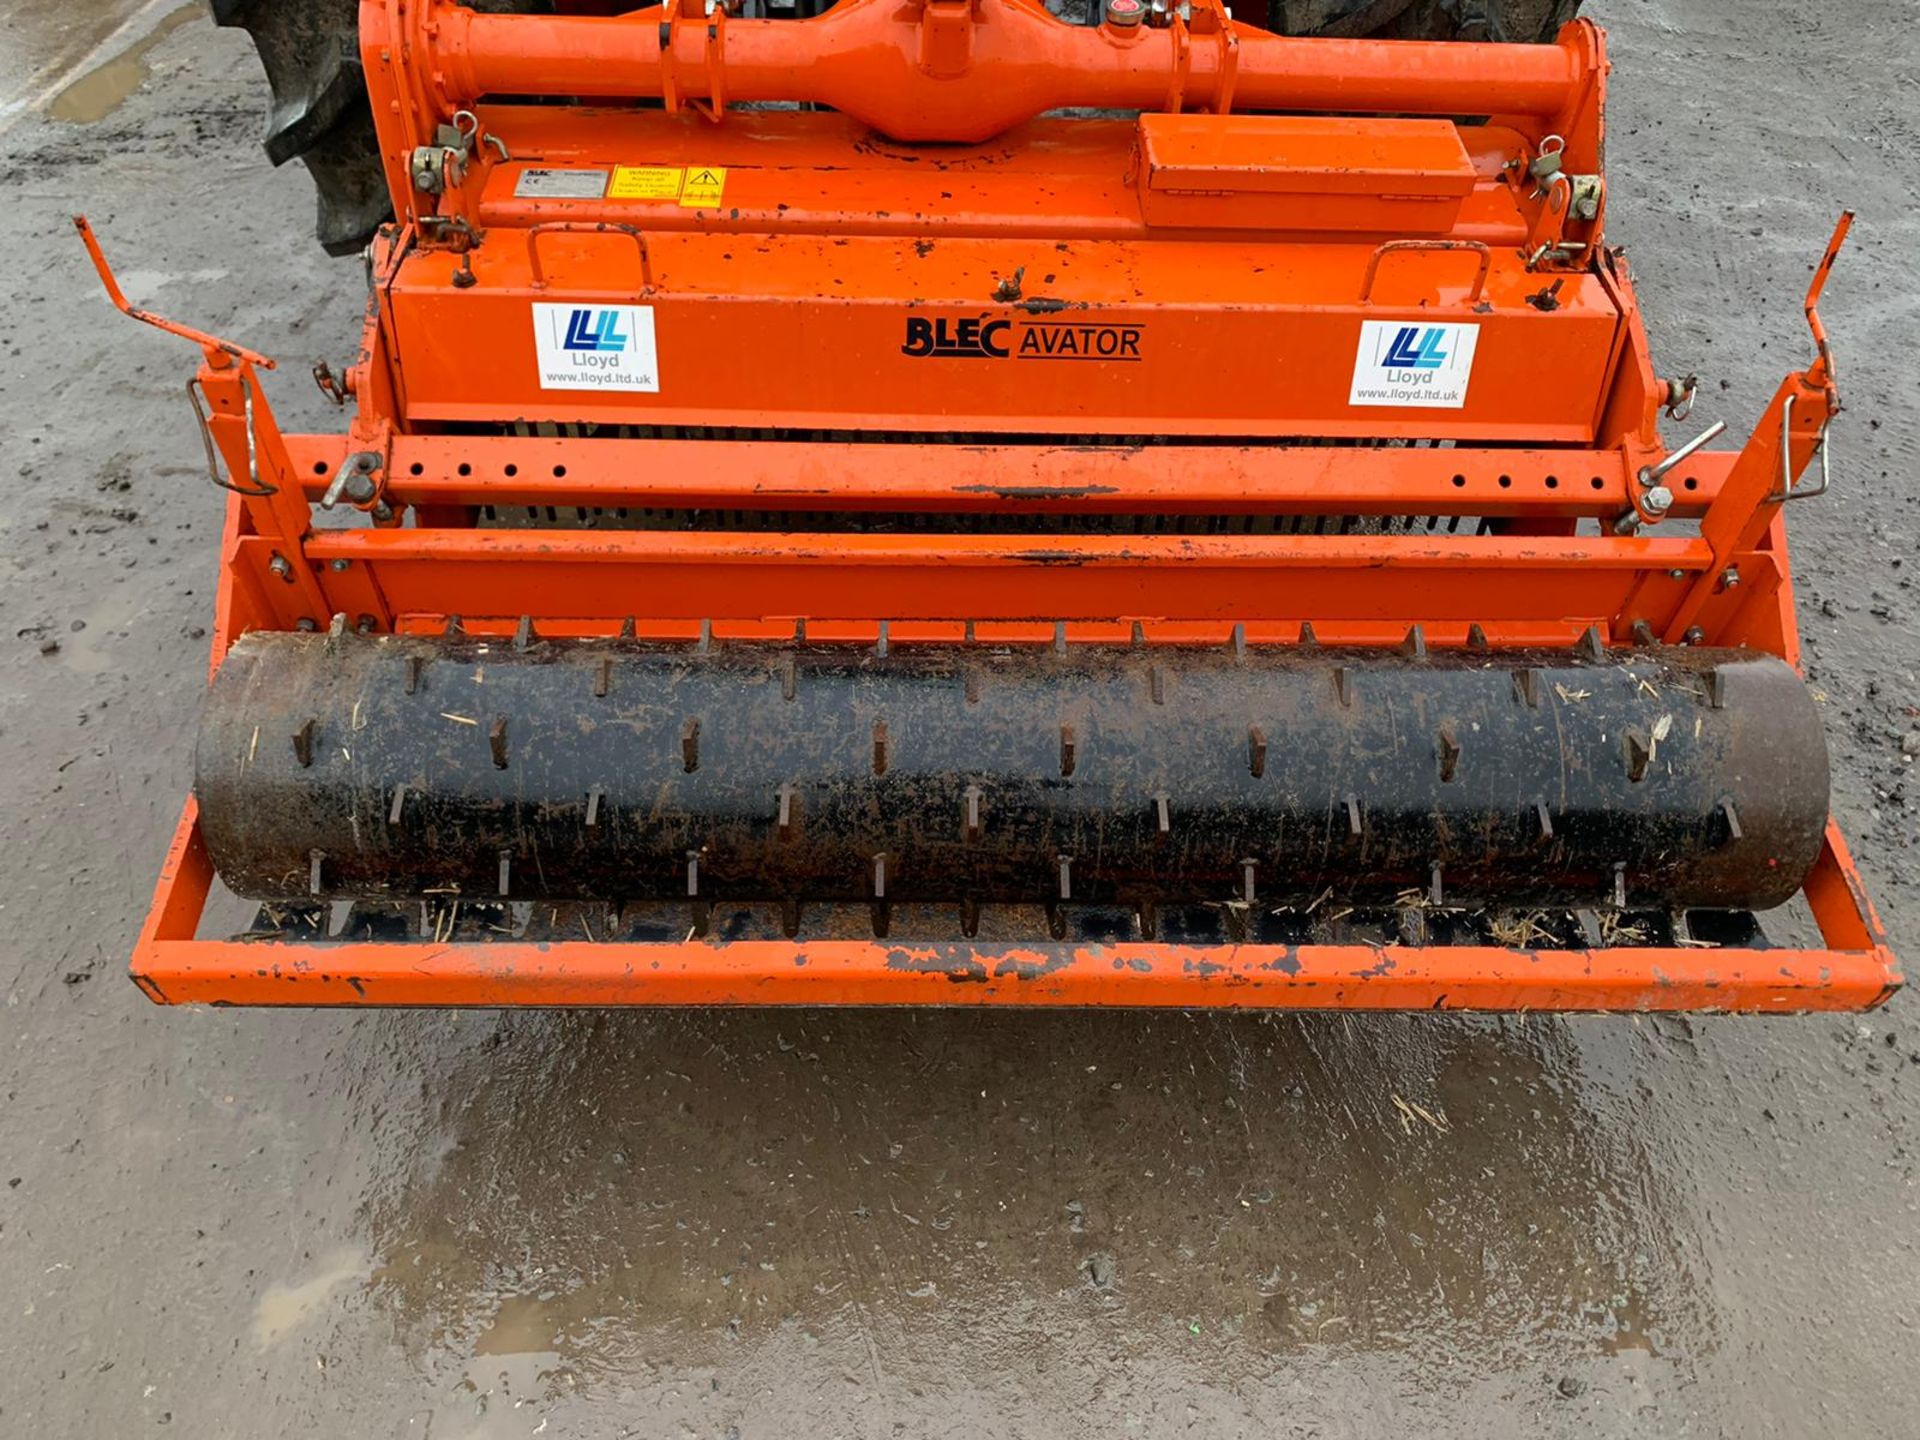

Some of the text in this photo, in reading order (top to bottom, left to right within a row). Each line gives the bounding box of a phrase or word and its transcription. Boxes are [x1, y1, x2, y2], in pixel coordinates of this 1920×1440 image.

[901, 317, 1141, 358] BLEC AVATOR
[572, 352, 620, 369] Lloyd
[546, 372, 652, 385] www.lloyd.ltd.uk
[1386, 369, 1434, 386] Lloyd
[1357, 388, 1459, 402] www.lloyd.ltd.uk
